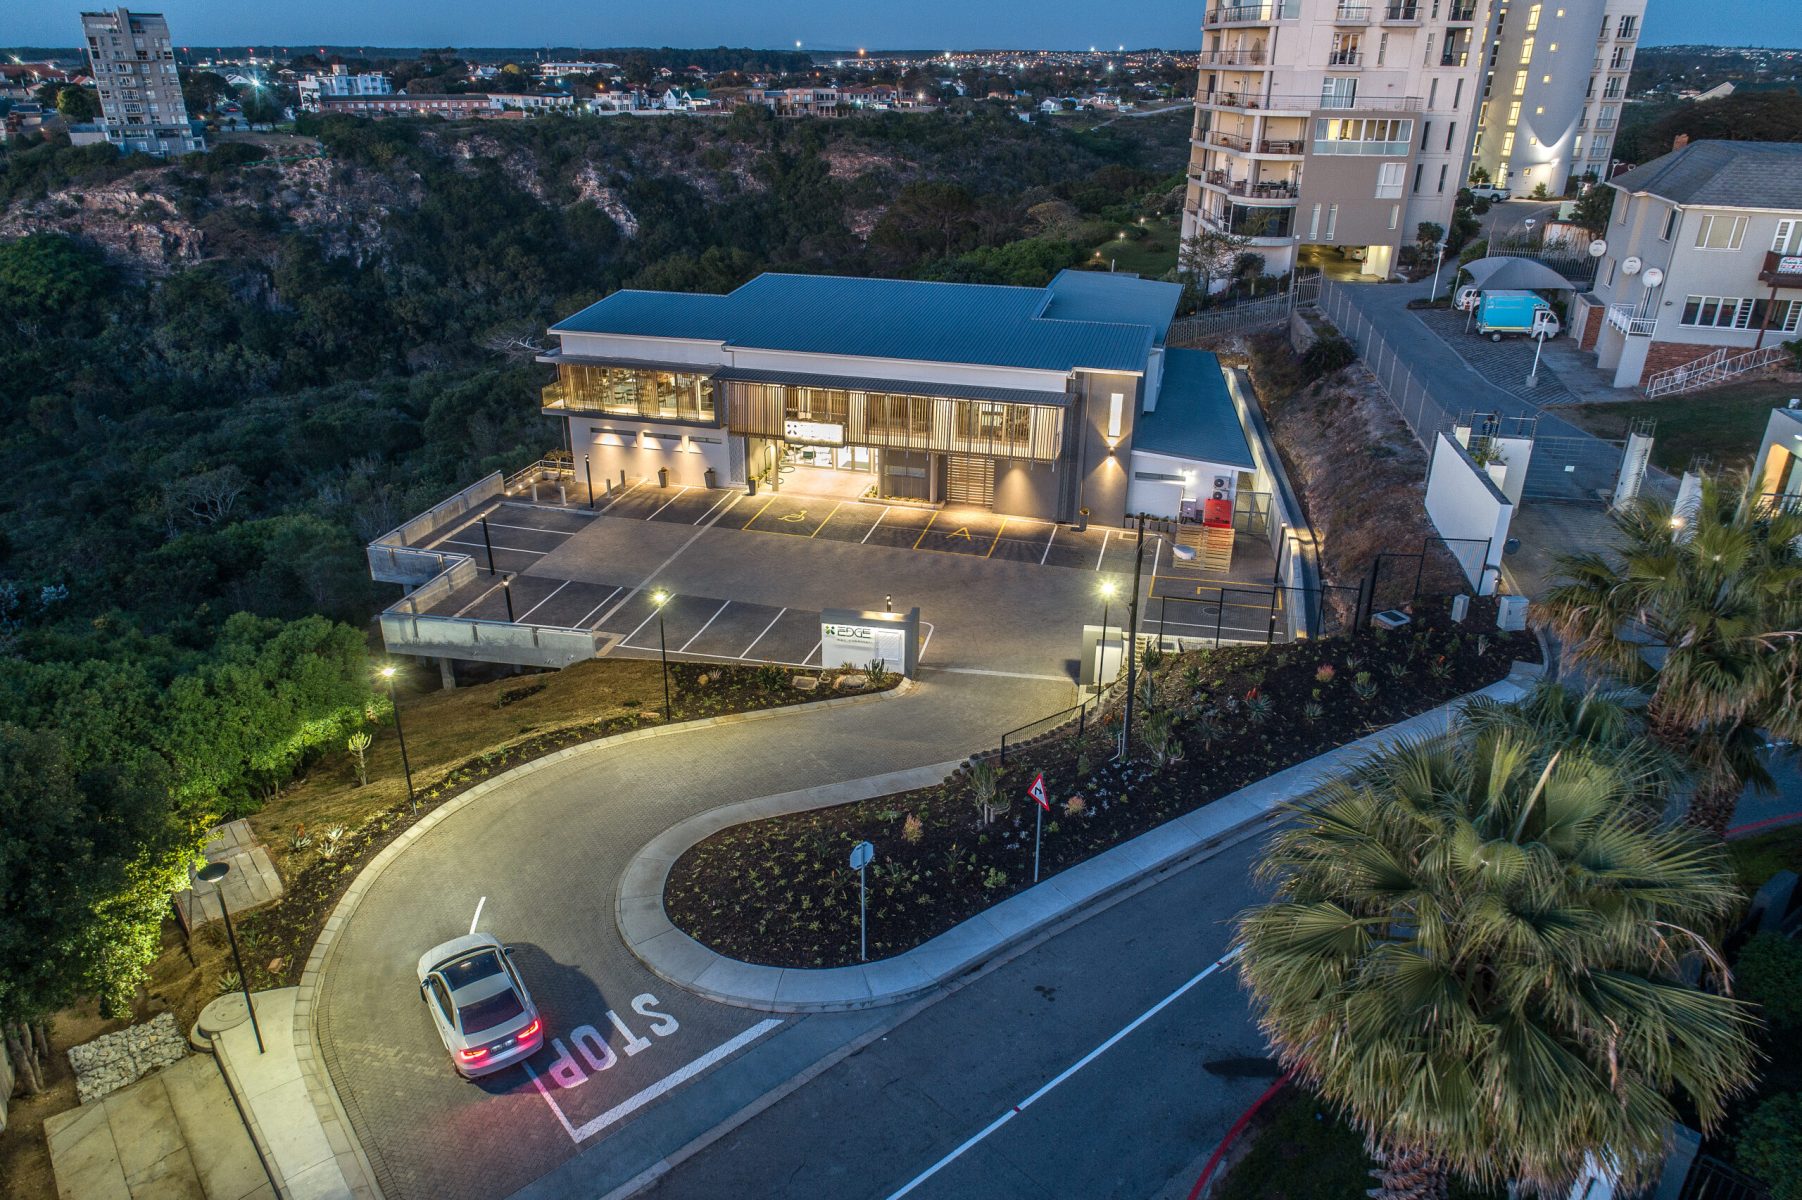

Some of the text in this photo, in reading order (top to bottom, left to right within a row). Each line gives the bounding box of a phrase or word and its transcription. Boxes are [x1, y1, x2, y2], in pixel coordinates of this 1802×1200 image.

[945, 527, 971, 541] A
[837, 626, 872, 639] EDGE
[549, 993, 679, 1089] STOP
